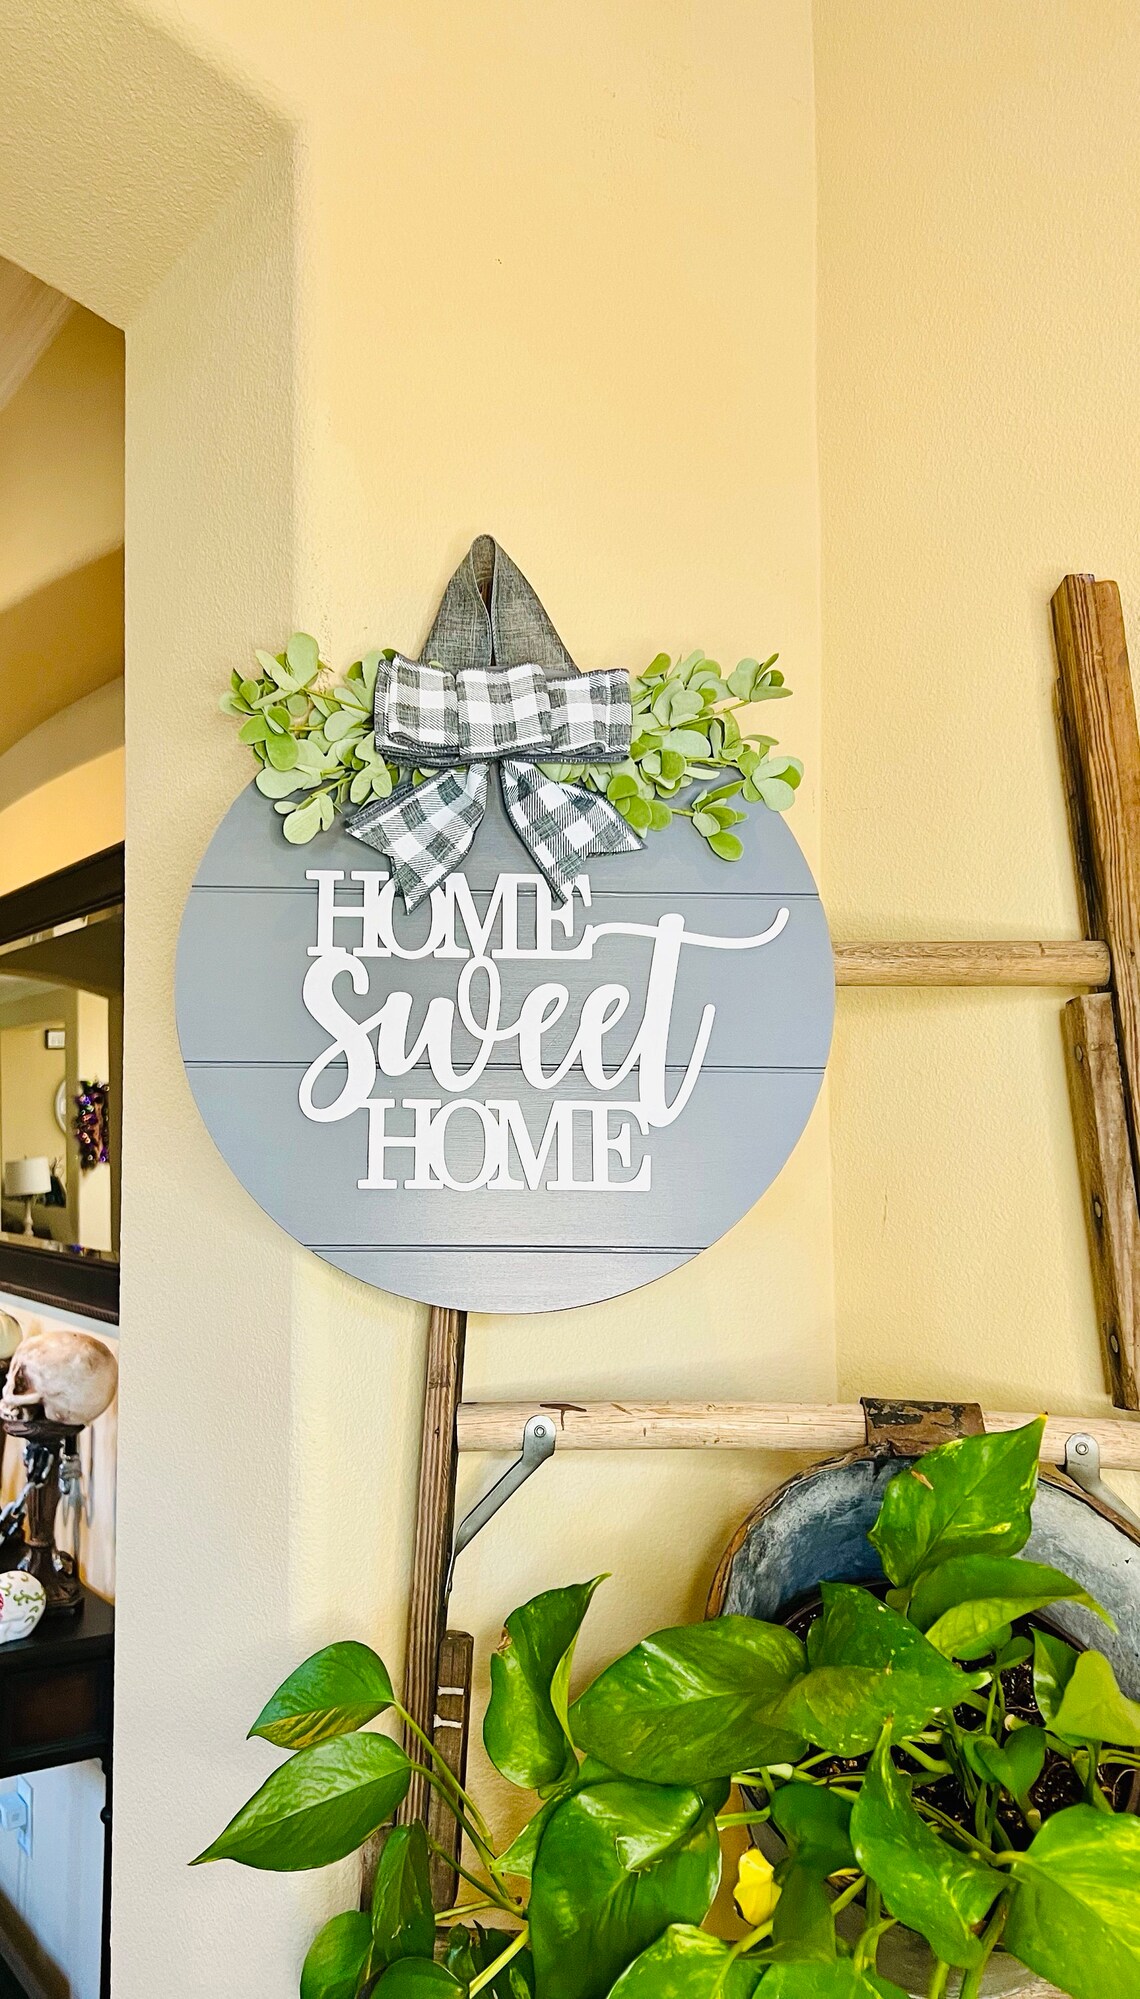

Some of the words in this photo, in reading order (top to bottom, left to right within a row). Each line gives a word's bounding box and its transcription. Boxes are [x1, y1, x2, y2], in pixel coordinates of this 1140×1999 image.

[305, 869, 593, 959] HOME
[299, 907, 790, 1128] Sweet
[357, 1098, 651, 1192] HOME
